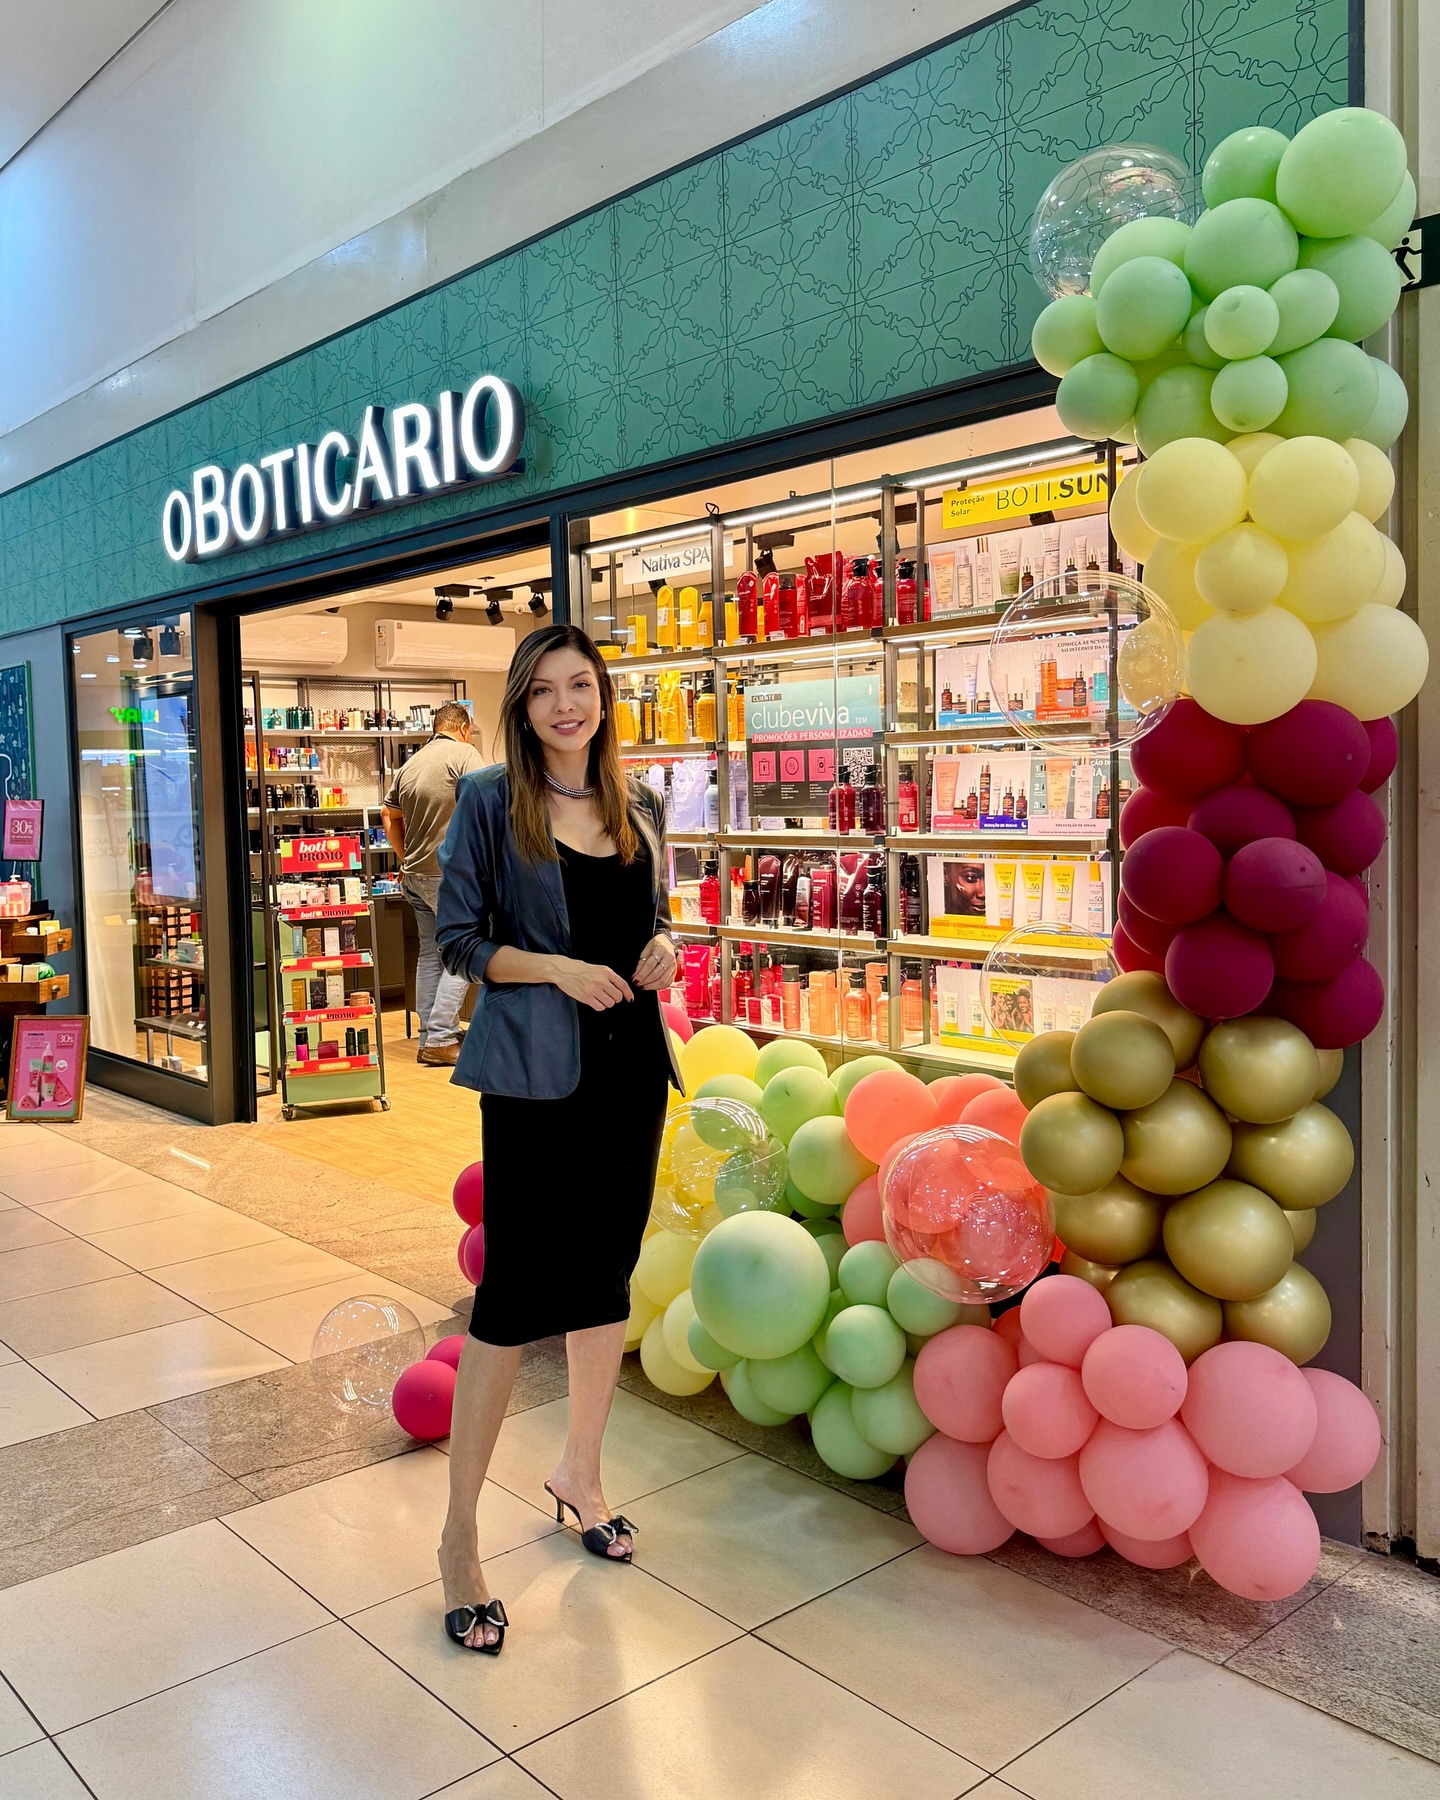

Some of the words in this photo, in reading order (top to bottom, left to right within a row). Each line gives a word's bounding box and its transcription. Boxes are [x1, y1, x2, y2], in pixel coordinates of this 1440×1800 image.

[951, 495, 985, 507] Proteção
[951, 508, 971, 517] Solar
[642, 554, 680, 574] Nativa
[683, 546, 710, 567] SPA
[752, 694, 775, 702] CLIENTE
[754, 731, 799, 743] PROMOÇÕES
[800, 728, 871, 740] PERSONAIZADAS!
[299, 841, 327, 853] boti
[299, 851, 343, 862] PROMO
[301, 910, 316, 918] boti
[322, 909, 350, 917] PROMO
[305, 1014, 320, 1022] boti
[326, 1012, 355, 1020] PROMO
